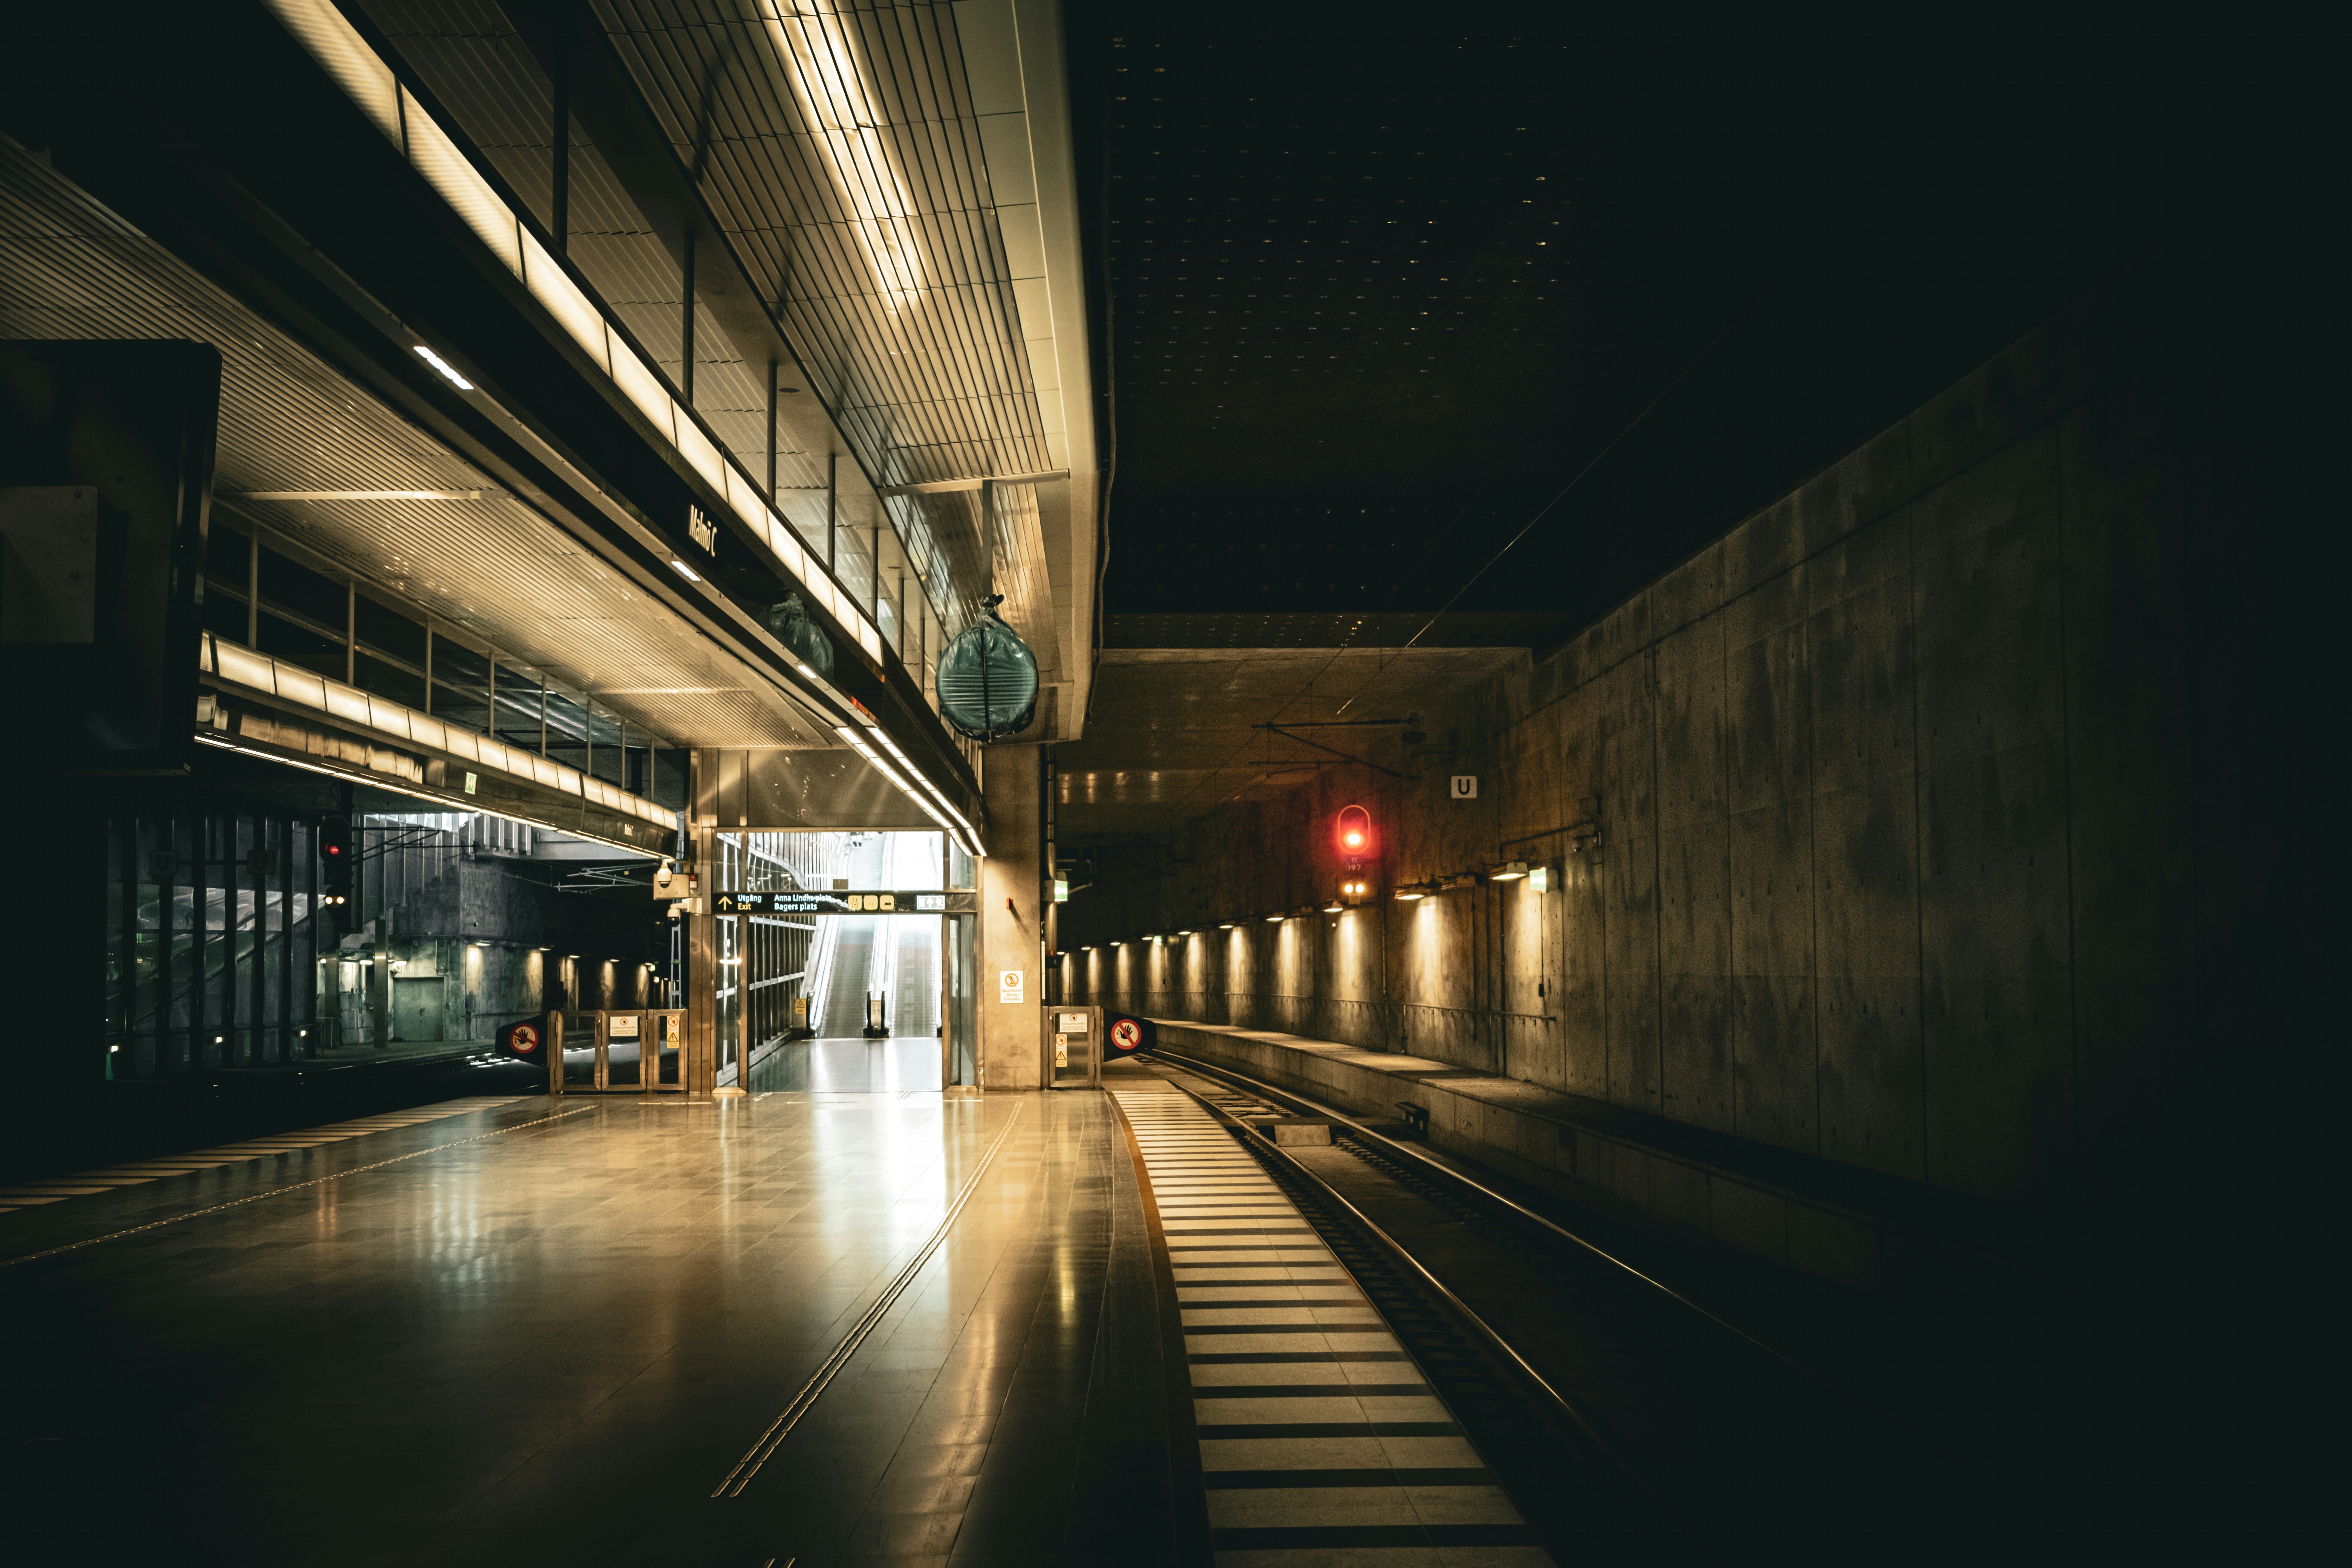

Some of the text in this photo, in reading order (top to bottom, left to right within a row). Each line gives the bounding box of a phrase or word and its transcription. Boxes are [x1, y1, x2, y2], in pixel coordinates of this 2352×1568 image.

[689, 504, 717, 557] Malmö C
[1458, 779, 1470, 795] U
[738, 894, 762, 903] Utgång
[775, 902, 818, 912] Bagers plats
